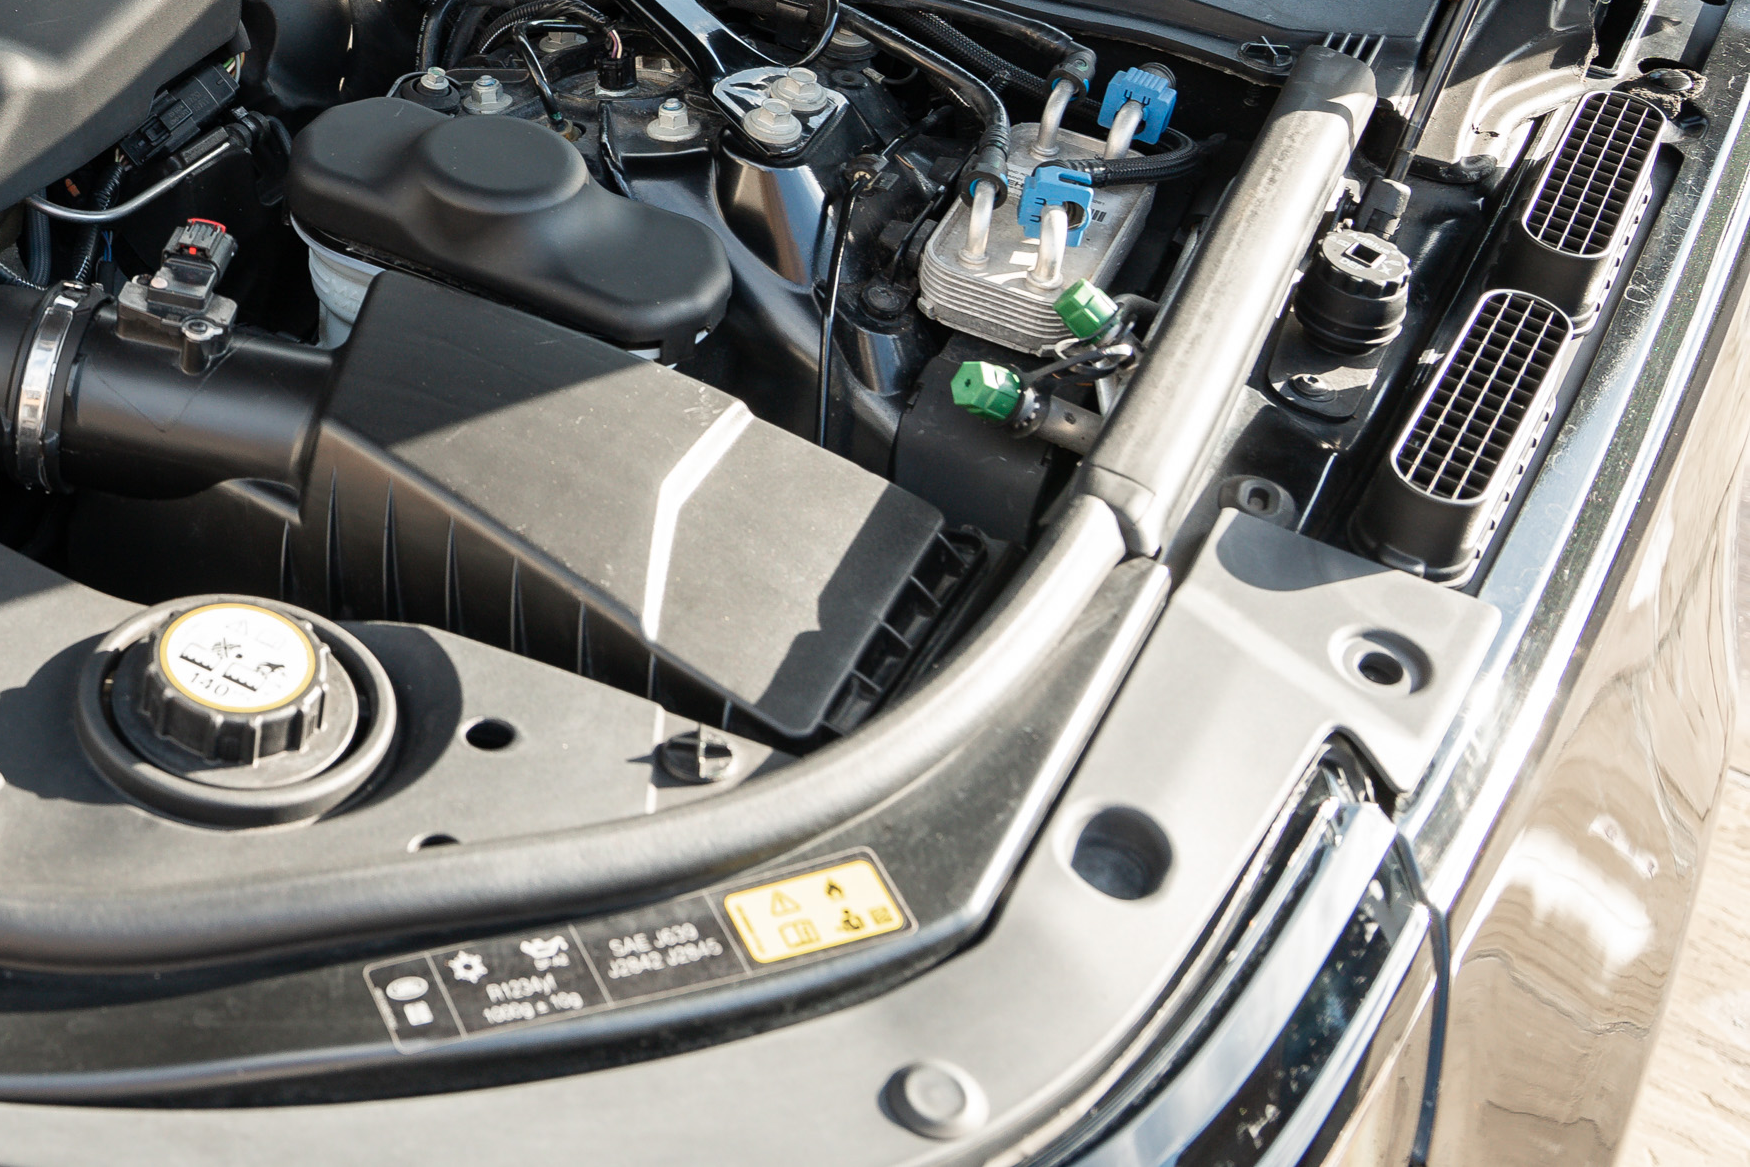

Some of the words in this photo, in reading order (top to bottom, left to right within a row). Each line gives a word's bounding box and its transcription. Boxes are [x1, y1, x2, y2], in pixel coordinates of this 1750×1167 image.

[1339, 257, 1366, 271] DEF
[609, 932, 653, 957] SAE
[486, 972, 558, 1003] R1234yf
